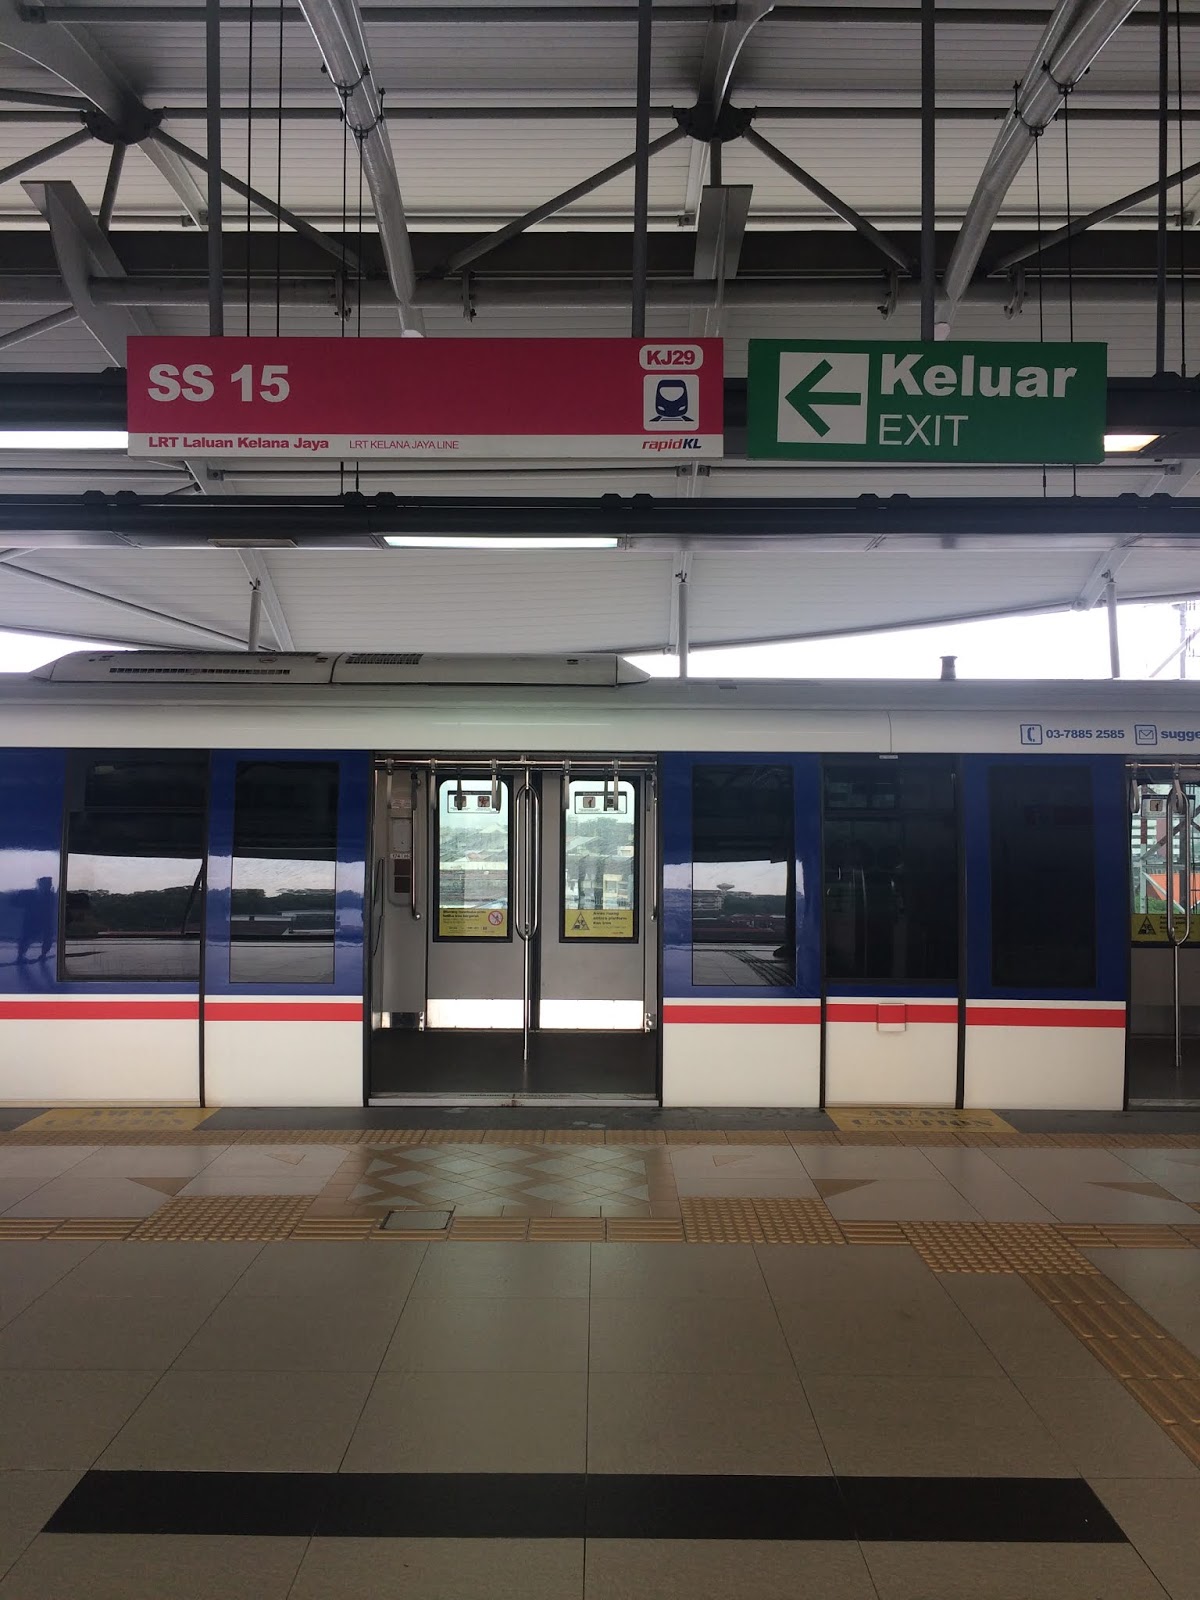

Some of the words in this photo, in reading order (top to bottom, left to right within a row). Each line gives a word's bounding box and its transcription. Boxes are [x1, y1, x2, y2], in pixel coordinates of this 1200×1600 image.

[646, 350, 696, 366] KJ29
[147, 363, 215, 402] SS
[230, 364, 291, 402] 15
[880, 353, 1078, 398] Keluar
[878, 414, 969, 447] EXIT
[148, 437, 179, 449] LRT
[182, 437, 234, 449] Laluan
[237, 437, 289, 449] Kelana
[293, 438, 329, 451] Jaya
[349, 440, 368, 449] LRT
[370, 440, 411, 449] KELANA
[411, 440, 436, 449] JAYA
[436, 440, 460, 449] LINE
[642, 438, 702, 452] rapidKL
[1045, 729, 1093, 739] 03-7885
[1095, 729, 1125, 739] 2585
[1160, 730, 1200, 742] sugge
